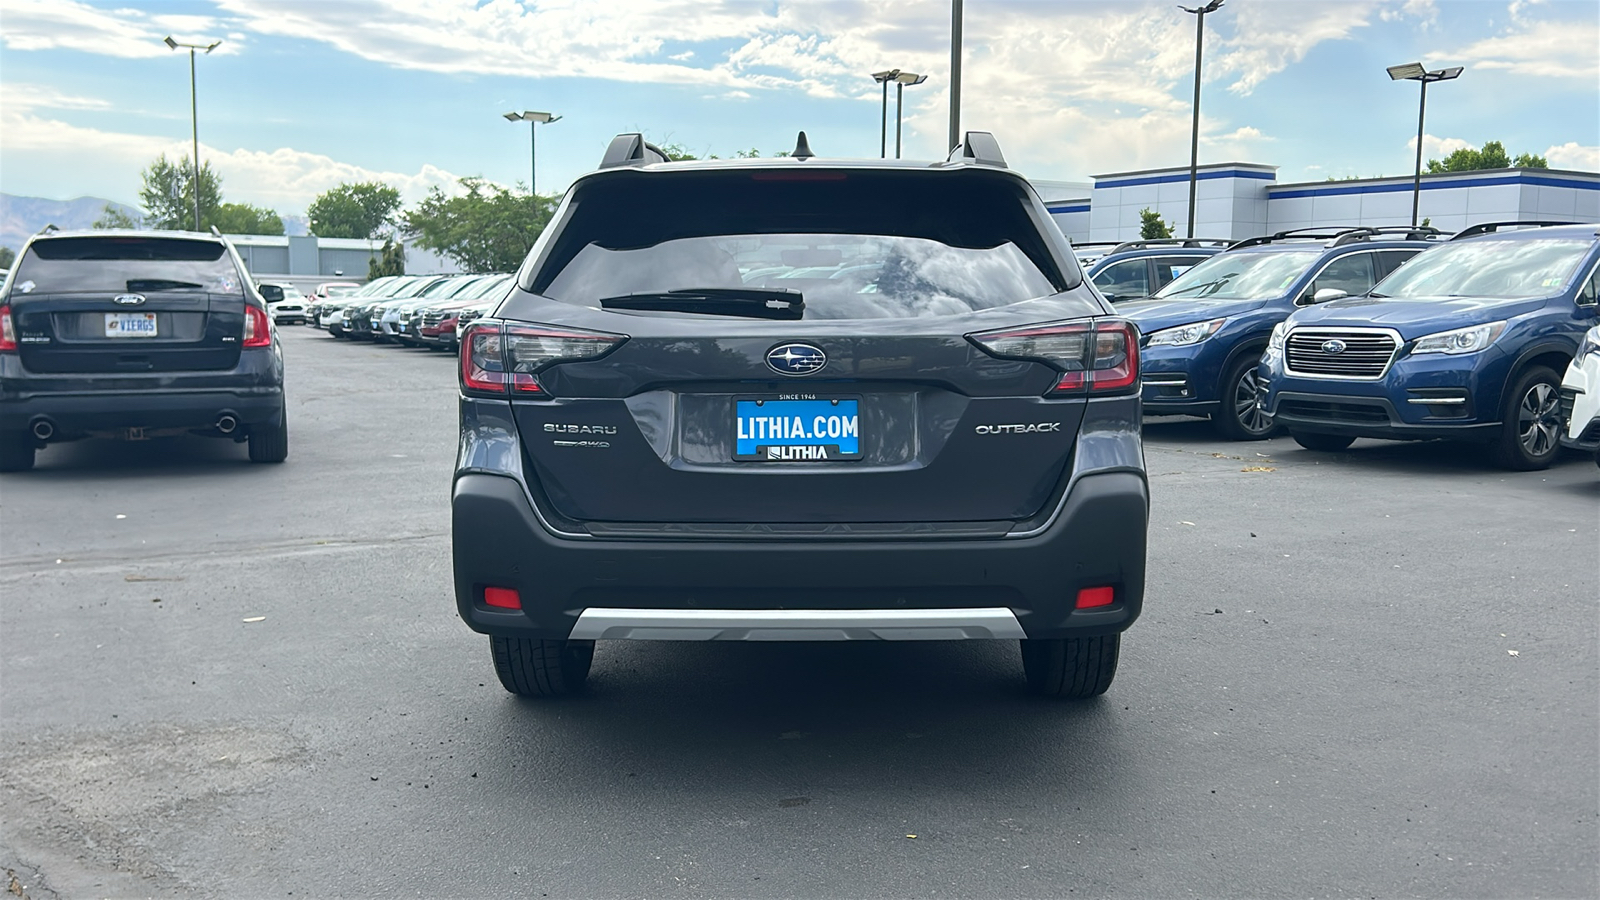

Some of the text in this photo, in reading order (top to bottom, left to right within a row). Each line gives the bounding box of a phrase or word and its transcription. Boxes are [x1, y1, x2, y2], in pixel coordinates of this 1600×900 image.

[543, 423, 617, 435] SUBARU
[737, 415, 859, 439] LITHIA.COM
[975, 422, 1061, 435] OUTBACK
[781, 445, 828, 459] LITHIA
